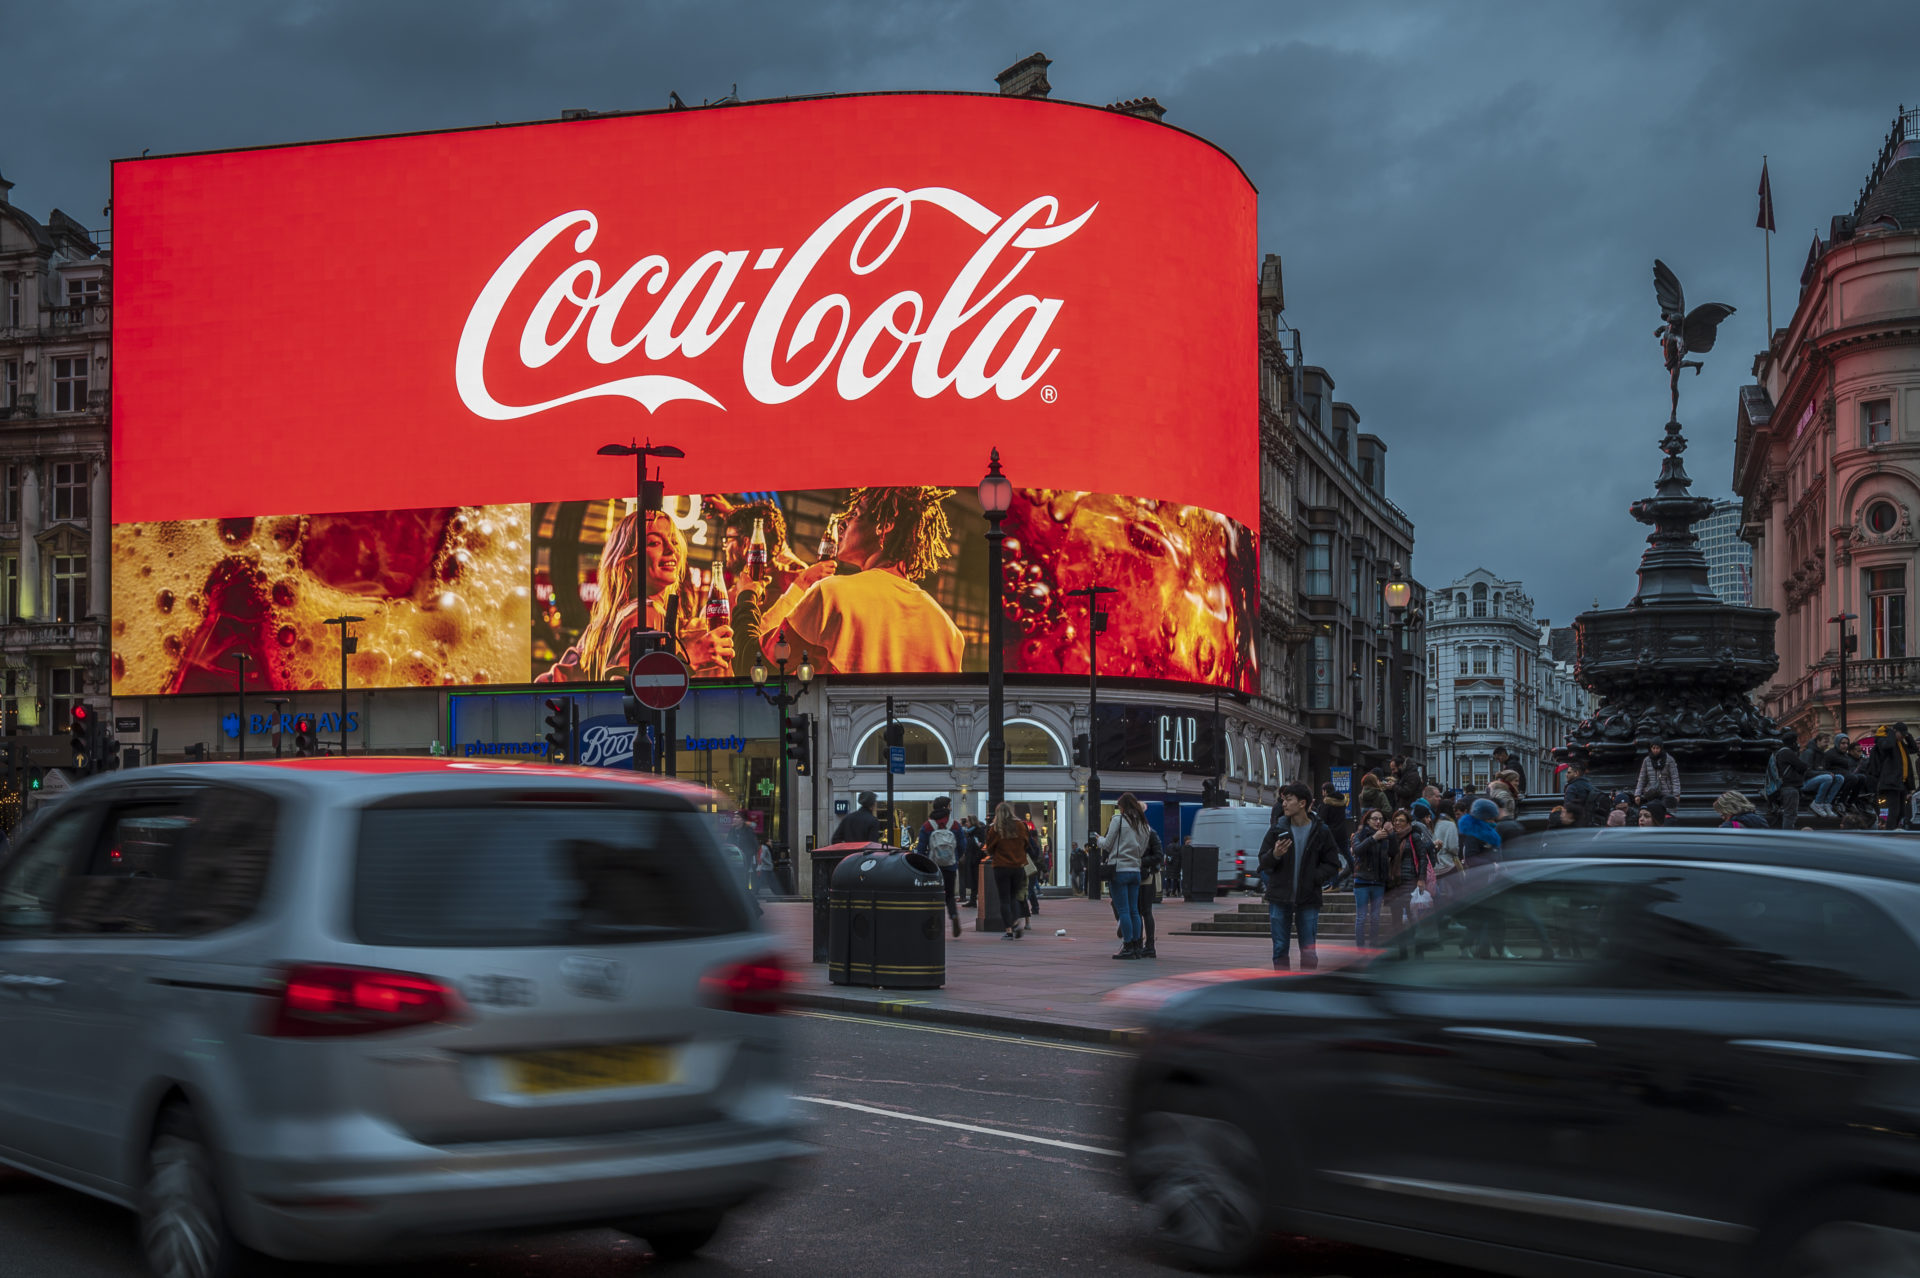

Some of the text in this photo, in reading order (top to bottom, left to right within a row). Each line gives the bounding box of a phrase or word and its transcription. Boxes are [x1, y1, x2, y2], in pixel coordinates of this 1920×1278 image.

[456, 187, 1100, 420] Coca-Cola
[249, 711, 359, 735] BARCAYS
[1160, 714, 1197, 763] GAP
[465, 739, 550, 757] pharmacy
[579, 725, 639, 766] Boot
[686, 734, 746, 753] beauty
